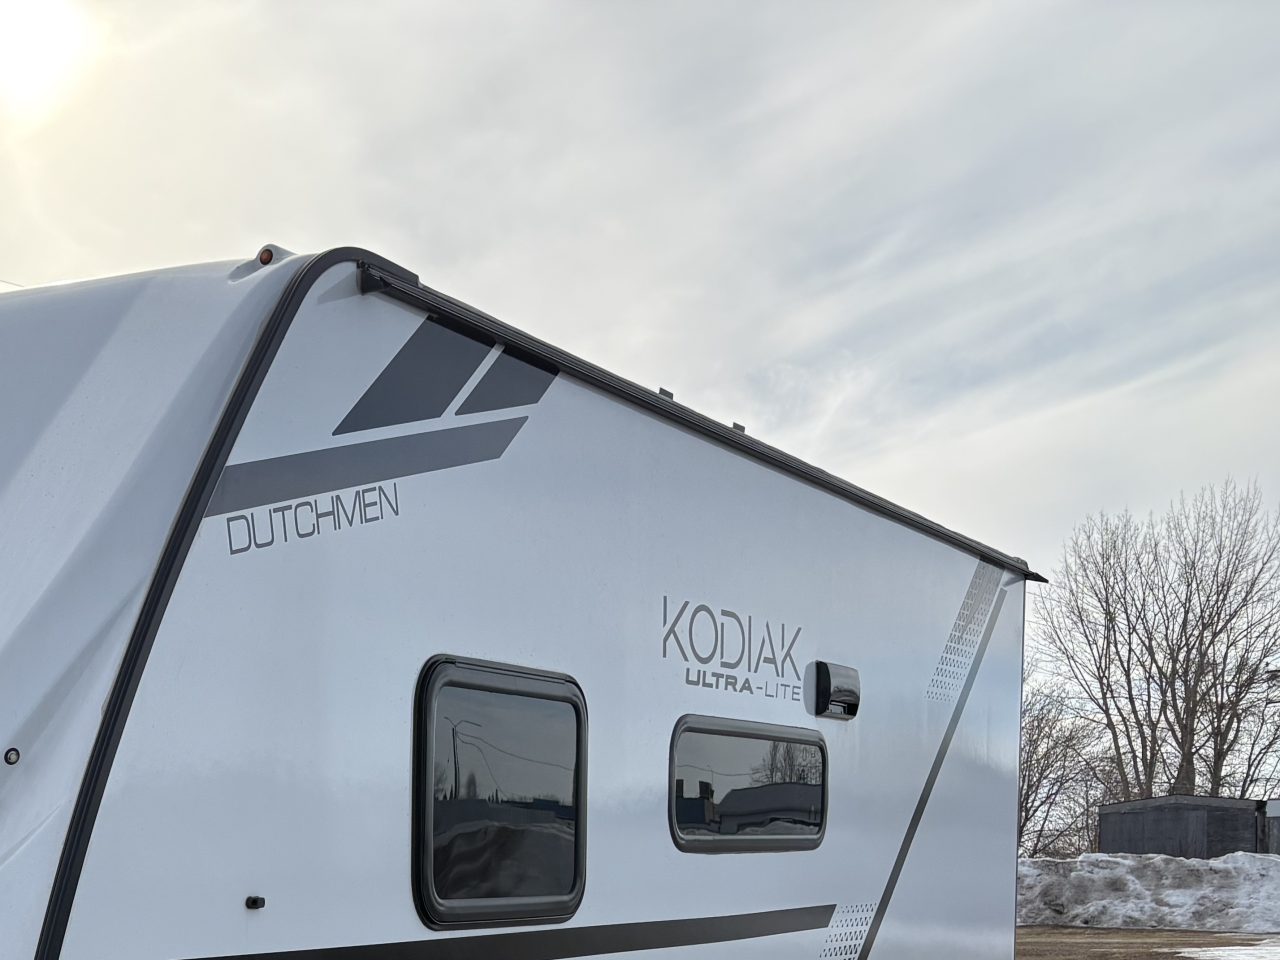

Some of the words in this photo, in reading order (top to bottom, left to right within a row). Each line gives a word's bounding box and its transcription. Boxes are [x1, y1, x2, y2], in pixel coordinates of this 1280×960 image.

[226, 482, 400, 555] DUTCHMEN
[662, 595, 802, 682] KODIAK
[685, 667, 802, 702] ULTRA-LITE
